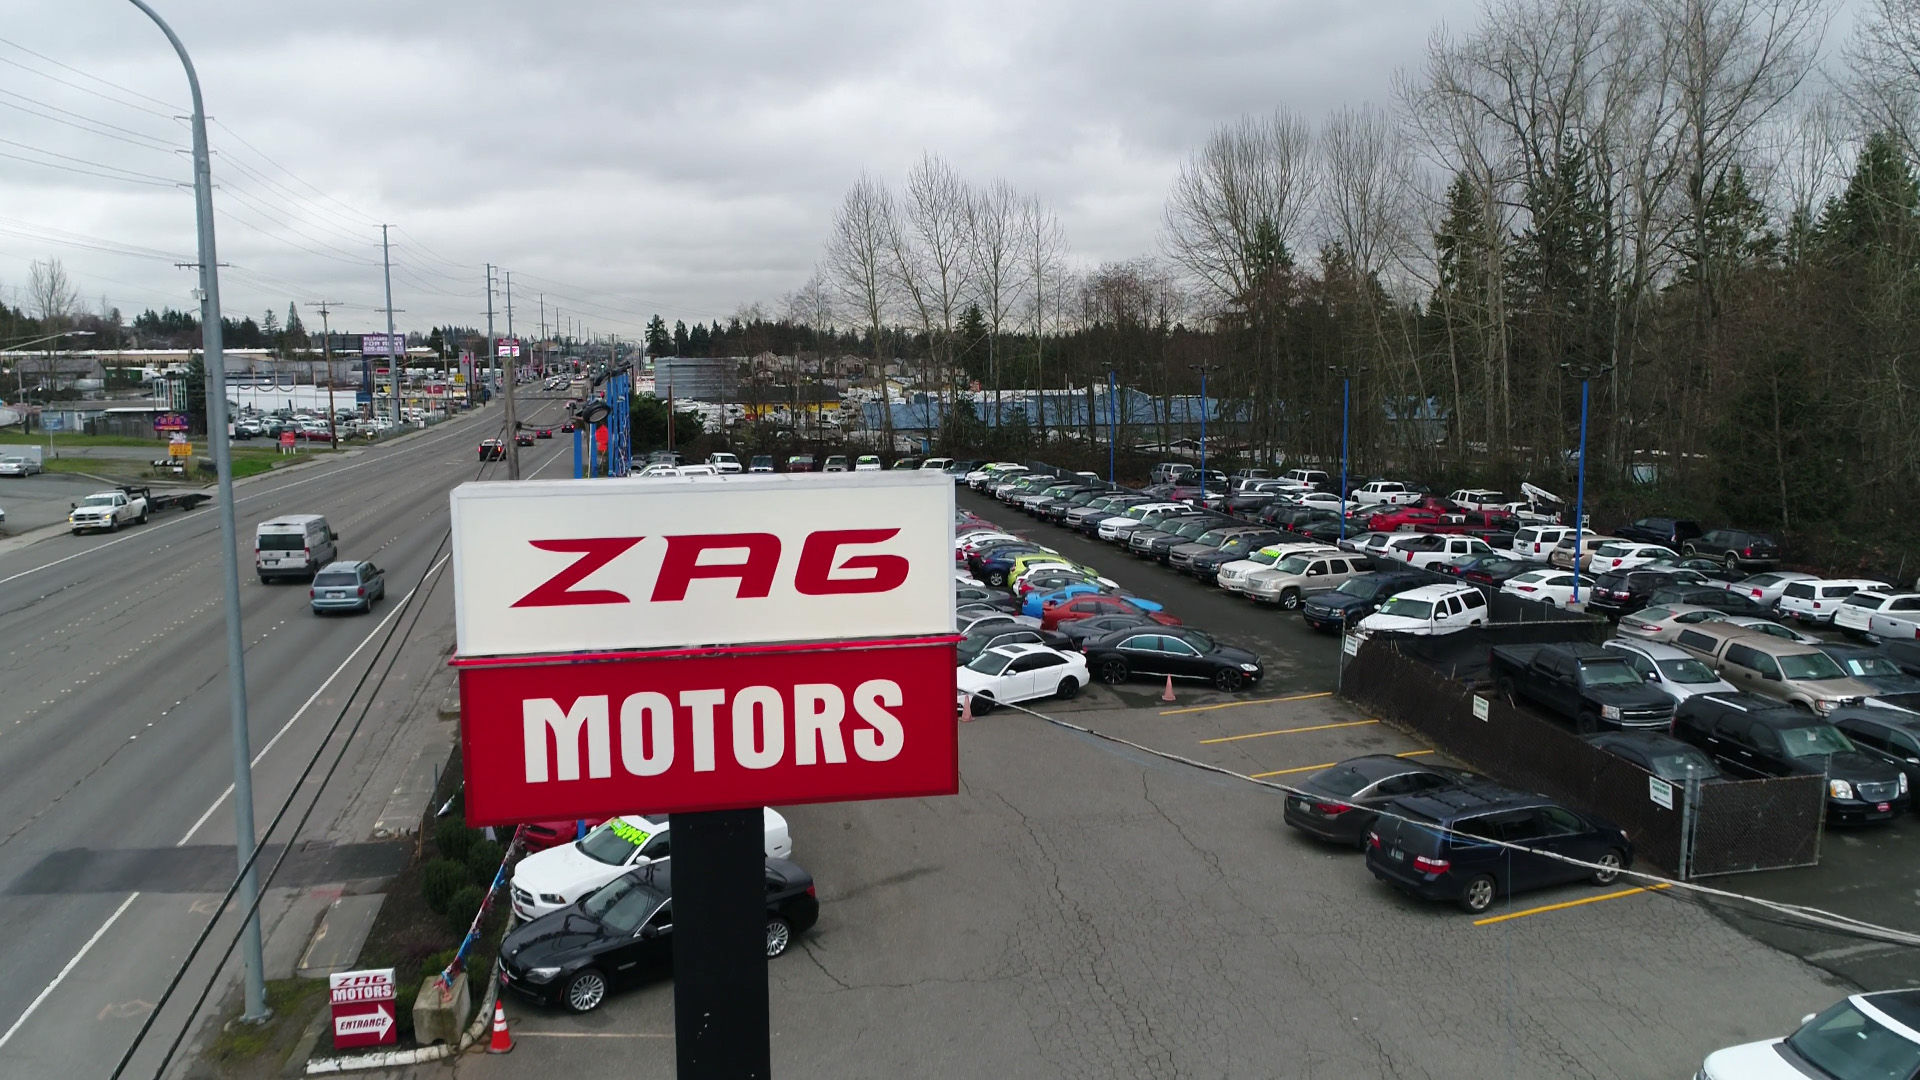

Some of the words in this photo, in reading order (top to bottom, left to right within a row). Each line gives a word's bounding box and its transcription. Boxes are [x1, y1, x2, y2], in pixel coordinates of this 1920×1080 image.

[509, 528, 910, 608] ZAG
[523, 679, 905, 784] MOTORS
[338, 975, 387, 986] ZAG
[333, 985, 391, 1001] MOTORS
[340, 1018, 387, 1030] ENTRANCE
